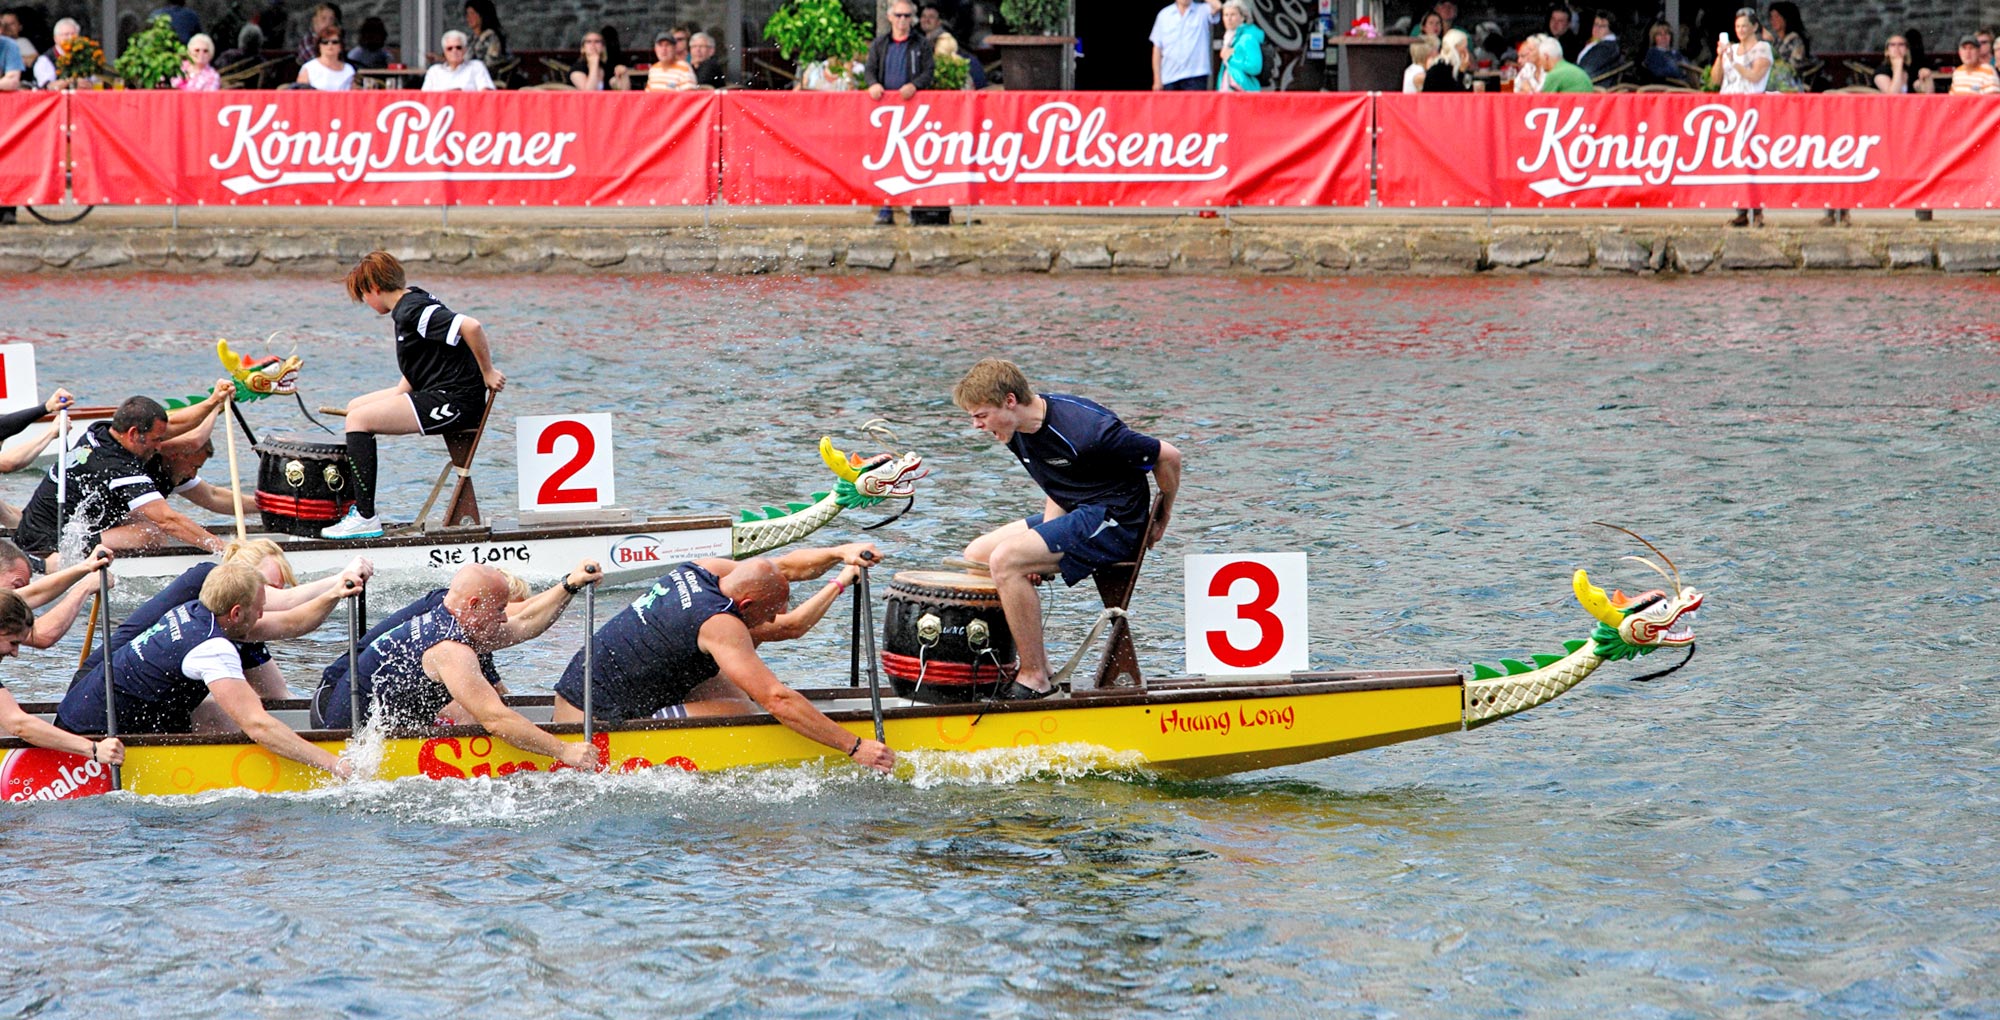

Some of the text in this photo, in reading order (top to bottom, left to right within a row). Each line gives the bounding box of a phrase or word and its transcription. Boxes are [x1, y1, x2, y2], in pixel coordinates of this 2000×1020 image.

[209, 100, 577, 182] König Pilsener
[861, 101, 1229, 182] König Pilsener
[1516, 103, 1881, 185] König Pilsener
[537, 421, 598, 504] 2
[619, 545, 660, 563] BuK
[1206, 561, 1284, 667] 3
[1160, 704, 1294, 736] Huang Long
